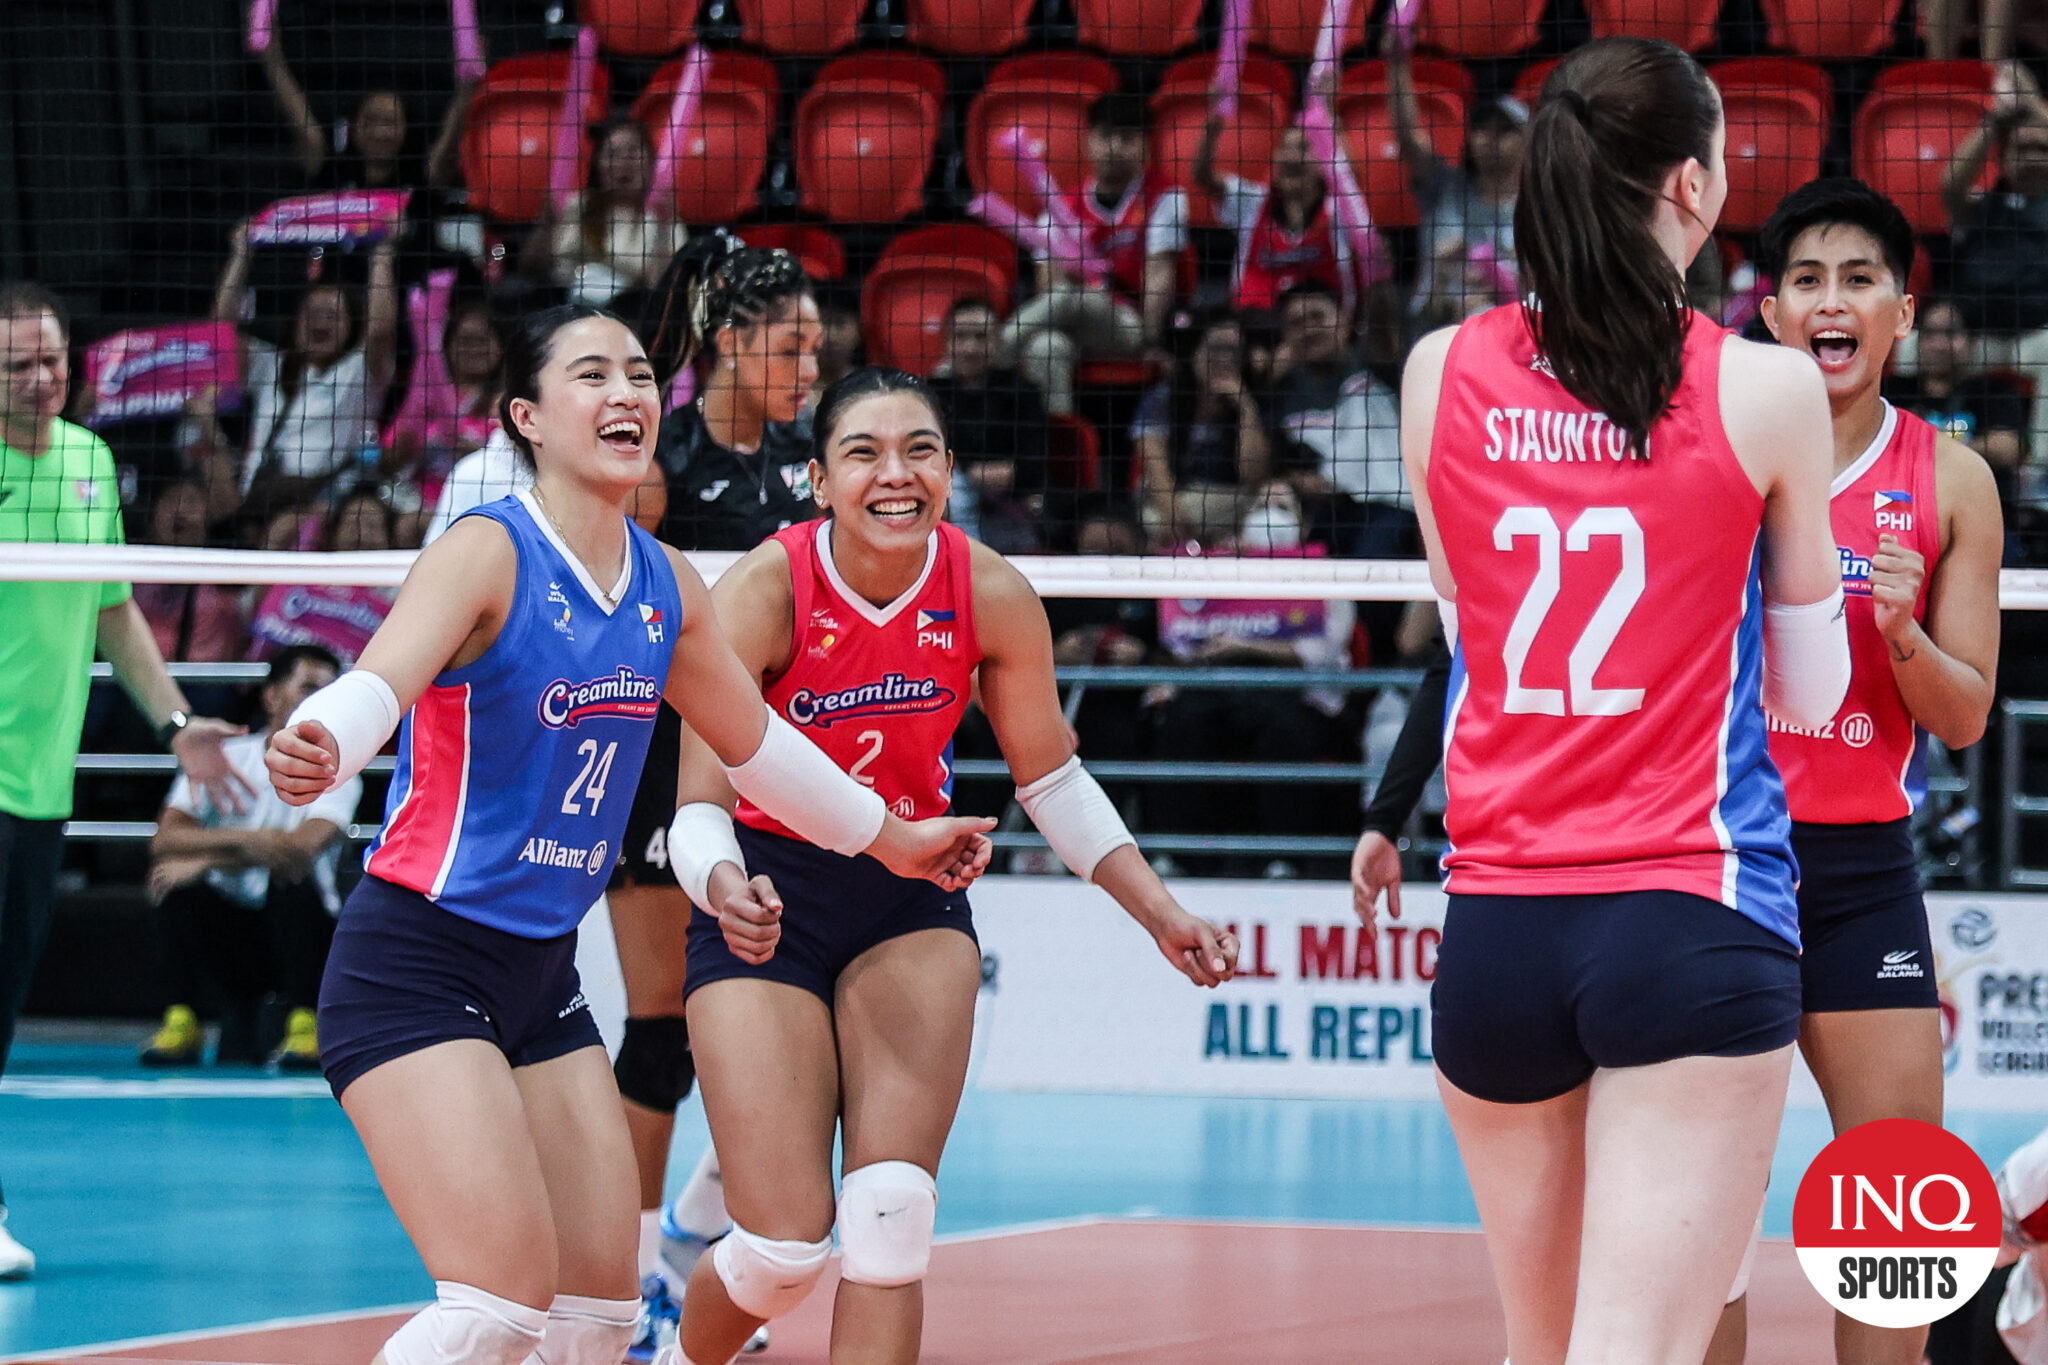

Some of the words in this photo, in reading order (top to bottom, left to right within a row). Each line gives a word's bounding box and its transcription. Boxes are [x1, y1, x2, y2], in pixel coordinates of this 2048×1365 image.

[1875, 511, 1913, 531] PHI
[1492, 506, 1646, 718] 22
[917, 631, 954, 650] PHI
[543, 669, 656, 725] Creamline
[788, 673, 936, 725] Creamline
[561, 738, 619, 817] 24
[848, 729, 884, 786] 2
[518, 837, 588, 869] Allianz
[644, 826, 669, 870] 4
[1300, 924, 1442, 981] MATC
[1205, 1003, 1289, 1060] ALL
[1311, 1005, 1435, 1061] REPL
